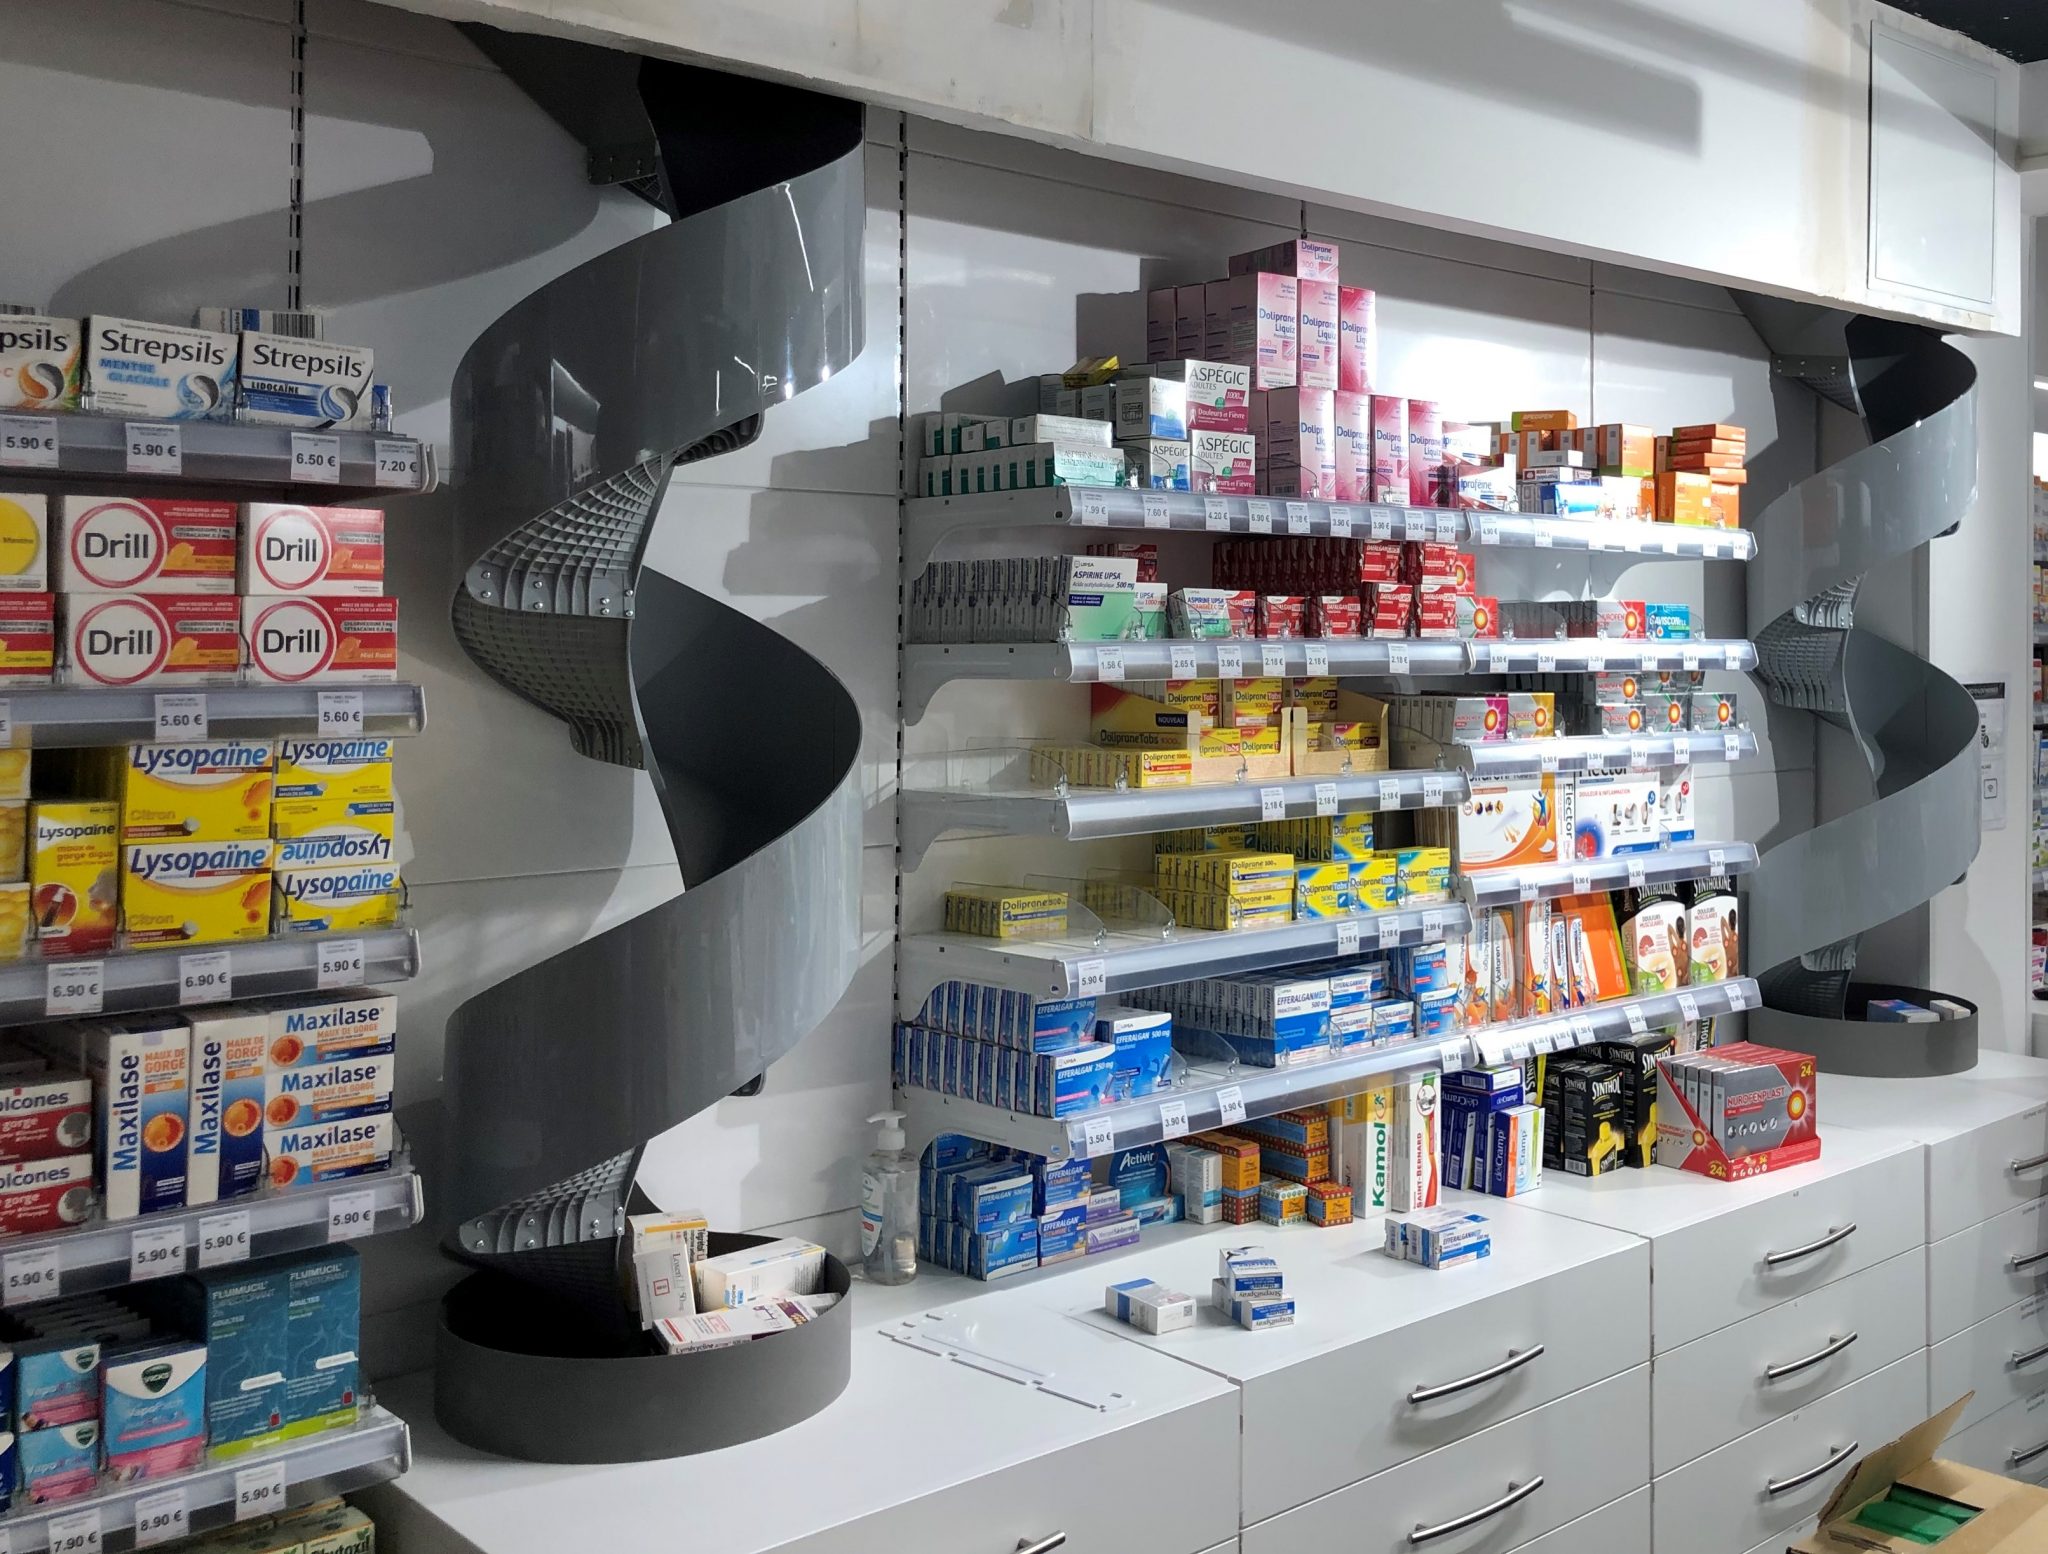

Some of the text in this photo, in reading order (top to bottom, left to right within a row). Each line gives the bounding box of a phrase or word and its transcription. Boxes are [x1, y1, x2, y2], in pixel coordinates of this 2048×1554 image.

[1259, 308, 1295, 323] Doliprane
[101, 328, 226, 366] Strepsils
[101, 358, 155, 374] MENTHE
[252, 343, 363, 379] Strepsils
[107, 371, 171, 388] GLACIALE
[1190, 365, 1245, 385] ASPÉGIC
[251, 381, 301, 394] LIDOCAÏNE
[6, 436, 54, 450] 5.90 €
[132, 444, 177, 457] 5.90 €
[1153, 444, 1188, 457] ASPÉGIC
[1196, 435, 1250, 454] ASPÉGIC
[296, 453, 337, 467] 6.50 €
[380, 459, 418, 472] 7.20 €
[1085, 505, 1099, 514] 7.99
[1208, 512, 1222, 520] 4.20
[85, 532, 149, 558] Drill
[266, 537, 317, 562] Drill
[1073, 571, 1121, 580] ASPIRINE UPSA
[89, 630, 153, 655] Drill
[264, 629, 319, 653] Drill
[1221, 659, 1235, 667] 3.90
[1168, 692, 1201, 704] Doliprane
[1235, 691, 1267, 703] Doliprane
[1294, 689, 1323, 700] Doliprane
[160, 714, 203, 727] 5.60 €
[323, 710, 360, 724] 5.60 €
[1158, 716, 1185, 724] NOUVEAU
[1242, 741, 1274, 754] Doliprane
[1335, 736, 1365, 749] Doliprane
[132, 741, 268, 775] Lysopaïne
[281, 738, 388, 766] Lysopaïne
[1143, 753, 1176, 764] Doliprane
[1265, 801, 1277, 810] 2.18
[1319, 797, 1330, 805] 2.18
[130, 808, 177, 821] Citron
[1565, 783, 1573, 839] Flector
[40, 823, 115, 841] Lysopaïne
[282, 833, 391, 864] Lysopaïne
[131, 844, 267, 880] Lysopaïne
[1231, 860, 1263, 870] Doliprane
[1400, 869, 1429, 880] Doliprane
[286, 868, 395, 901] Lysopaïne
[1300, 884, 1332, 897] Doliprane
[1350, 877, 1381, 889] Doliprane
[1002, 899, 1046, 911] Doliprane
[323, 958, 360, 973] 5.90 €
[185, 972, 227, 988] 6.90 €
[1082, 976, 1097, 985] 5.90
[53, 983, 98, 996] 6.90 €
[1277, 990, 1327, 1006] EFFERALGANMED
[1037, 1003, 1073, 1015] EFFERALGAN
[1075, 1001, 1086, 1009] 250
[285, 1007, 381, 1033] Maxilase
[226, 1038, 250, 1048] MAUX
[1116, 1031, 1150, 1044] EFFERALGAN
[1151, 1030, 1162, 1038] 500
[144, 1051, 172, 1061] MAUX
[226, 1045, 264, 1060] GORGE
[1609, 1047, 1636, 1065] SYNTHOL
[144, 1058, 186, 1073] GORGE
[1057, 1062, 1114, 1080] EFFERALGAN 250 mg
[281, 1066, 376, 1093] Maxilase
[1564, 1077, 1587, 1093] SYNTHOL
[1592, 1075, 1622, 1100] SYNTHOL
[194, 1041, 222, 1156] Maxilase
[1727, 1087, 1785, 1107] NUROFENPLAST
[113, 1055, 140, 1171] Maxilase
[1223, 1102, 1236, 1113] 3.90
[2, 1118, 39, 1132] gorge
[1165, 1117, 1179, 1127] 3.90
[280, 1125, 376, 1154] Maxilase
[1089, 1134, 1105, 1144] 3.50
[1120, 1150, 1155, 1172] Activir
[1372, 1122, 1386, 1207] Kamol
[1049, 1165, 1083, 1180] EFFERALGAN
[4, 1193, 41, 1209] gorge
[333, 1210, 371, 1225] 5.90 €
[1043, 1217, 1080, 1232] EFFERALGAN
[204, 1232, 246, 1249] 5.90 €
[138, 1246, 181, 1263] 5.90 €
[9, 1269, 54, 1286] 5.90 €
[289, 1264, 342, 1280] FLUIMUCIL
[212, 1281, 268, 1299] FLUIMUCIL
[241, 1484, 282, 1504] 5.90 €
[141, 1511, 182, 1530] 8.90 €
[54, 1532, 97, 1552] 7.90 €
